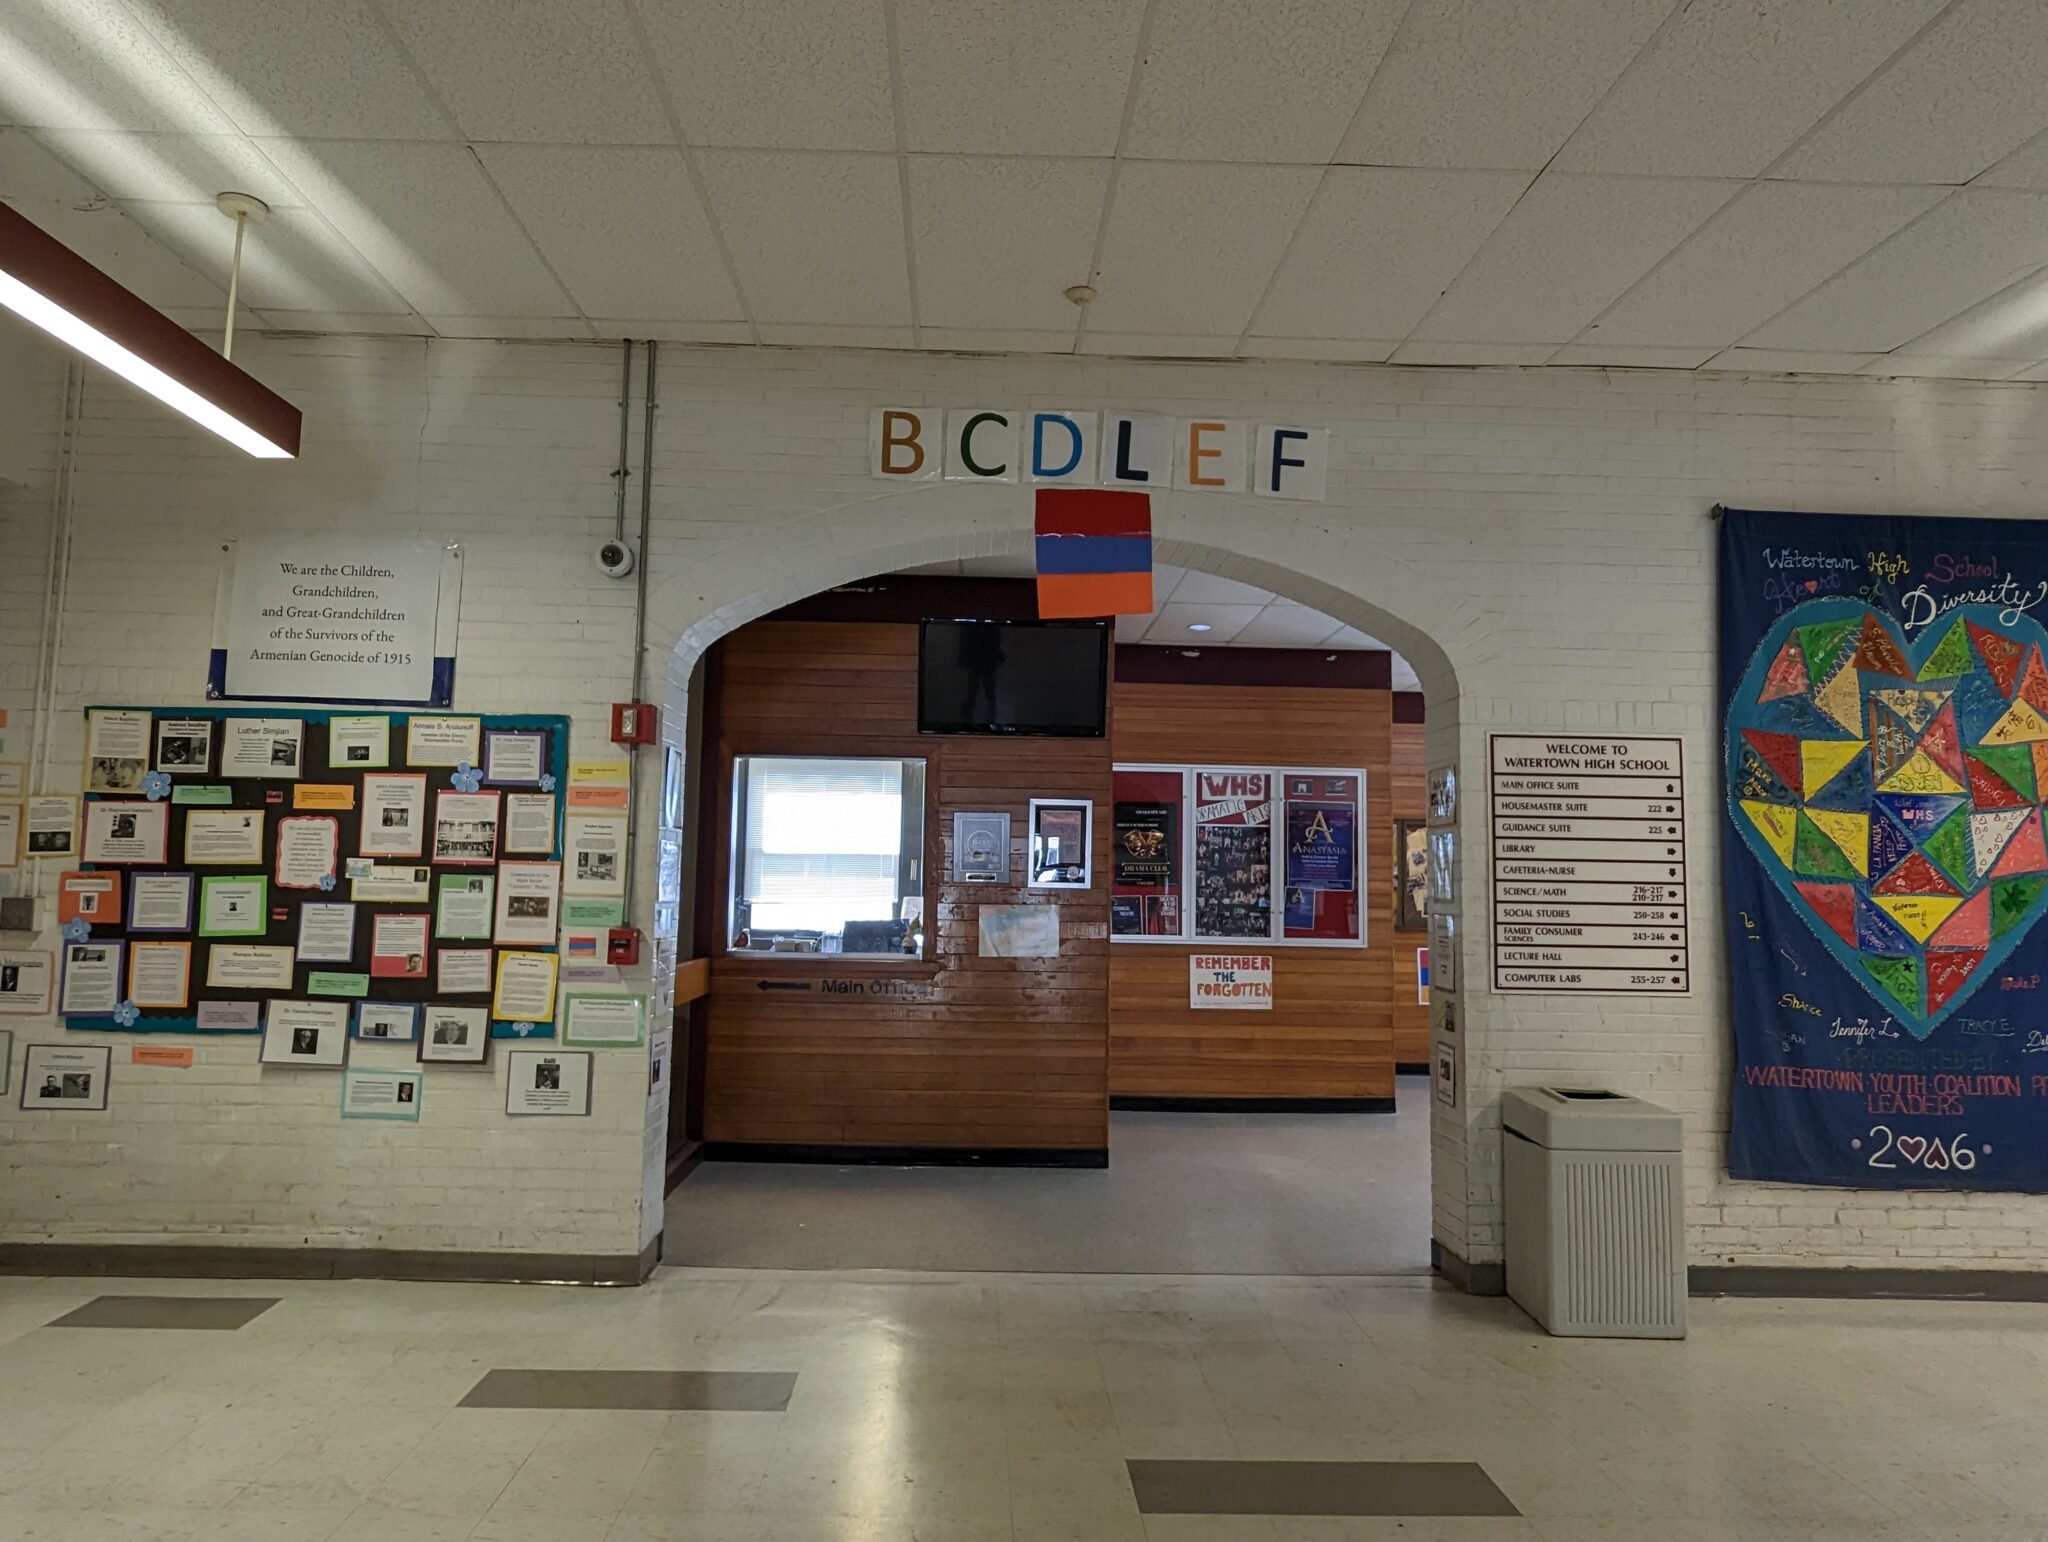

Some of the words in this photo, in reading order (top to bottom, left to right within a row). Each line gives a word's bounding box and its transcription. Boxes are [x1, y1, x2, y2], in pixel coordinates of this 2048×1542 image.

[880, 410, 925, 474] B
[960, 412, 1008, 477] C
[1032, 413, 1083, 477] D
[1116, 420, 1149, 481] L
[1189, 422, 1226, 486] E
[1271, 429, 1309, 492] F
[280, 563, 298, 575] We
[300, 566, 317, 576] are
[320, 564, 338, 576] the
[340, 565, 394, 579] Children,
[1762, 548, 1859, 571] Watertown
[1867, 551, 1910, 584] High
[1924, 552, 1999, 583] School
[292, 585, 379, 599] Grandchildren,
[1901, 572, 2048, 630] Diversity
[261, 606, 283, 617] and
[286, 606, 405, 621] Great-Grandchildren
[269, 627, 285, 639] of
[285, 628, 303, 640] the
[305, 629, 358, 641] Survivors
[361, 630, 376, 642] of
[376, 630, 395, 642] the
[250, 649, 306, 661] Armenian
[310, 650, 365, 663] Genocide
[367, 652, 382, 664] of
[384, 653, 412, 664] 1915
[1546, 744, 1607, 755] WELCOME
[1611, 745, 1628, 755] TO
[1505, 757, 1580, 769] WATERTOWN
[1585, 759, 1615, 770] HIGH
[1620, 760, 1670, 771] SCHOOL
[1205, 774, 1263, 797] WHS
[1501, 781, 1523, 789] MAIN
[1526, 781, 1554, 790] OFFICE
[1557, 782, 1580, 790] SUITE
[1196, 799, 1244, 823] DRAMATIC
[1501, 802, 1562, 811] HOUSEMASTER
[1565, 803, 1588, 812] SUITE
[1647, 805, 1662, 813] 222
[1902, 809, 1934, 820] WHS
[1502, 823, 1546, 832] GUIDANCE
[1549, 824, 1571, 833] SUITE
[1648, 826, 1662, 834] 225
[1502, 844, 1536, 853] LIBRARY
[1502, 866, 1576, 875] CAFETERIA-NURSE
[1503, 887, 1567, 896] SCIENCE/MATH
[1633, 886, 1664, 894] 216-217
[1503, 908, 1534, 917] SOCIAL
[1536, 909, 1570, 918] STUDIES
[1633, 911, 1665, 920] 250-258
[1503, 927, 1532, 935] FAMILY
[1535, 927, 1583, 936] CONSUMER
[1632, 933, 1665, 941] 243-246
[1504, 952, 1539, 960] LECTURE
[1542, 952, 1562, 961] HALL
[1195, 957, 1271, 971] REMEMBER
[1213, 971, 1236, 983] THE
[1505, 973, 1556, 983] COMPUTER
[1559, 974, 1581, 983] LABS
[1631, 976, 1666, 984] 255-257
[821, 979, 864, 994] Main
[1196, 982, 1272, 998] FORGOTTEN
[1829, 1017, 1877, 1045] Jennifer
[1745, 1066, 1863, 1093] WATERTOWN
[1869, 1072, 1927, 1095] YOUTH
[1934, 1074, 2022, 1097] COALITION
[1866, 1093, 1965, 1116] LEADERS
